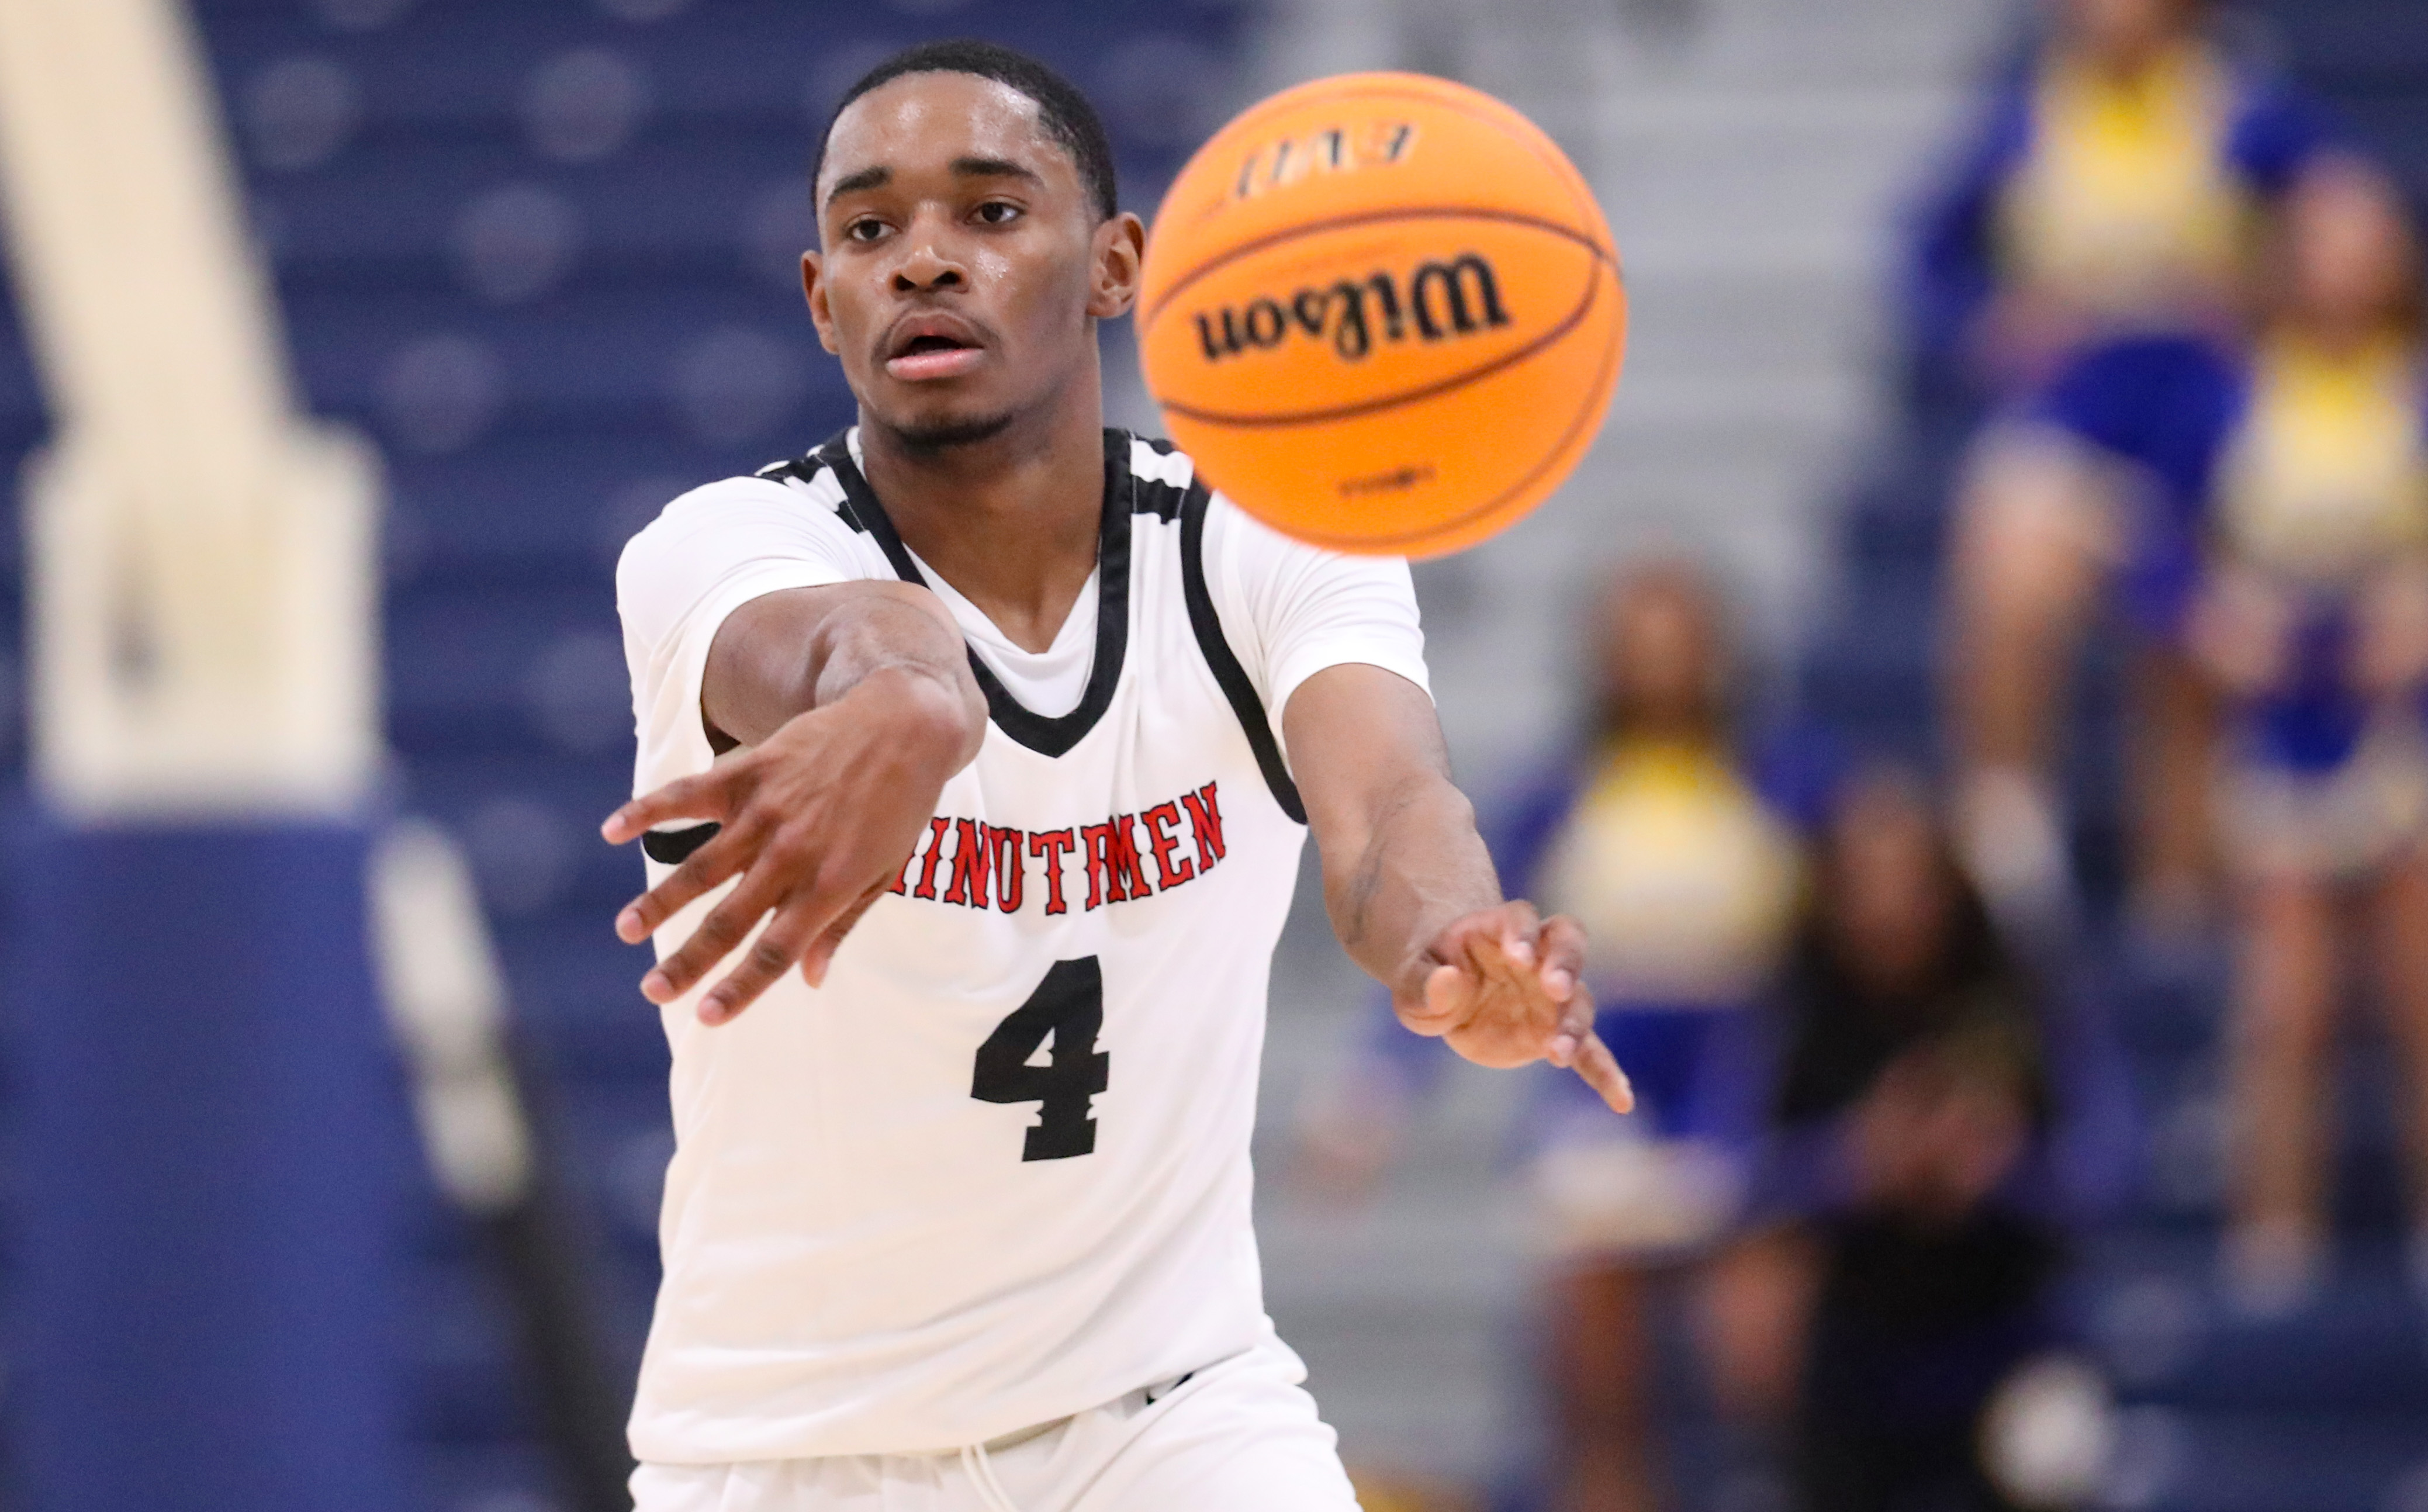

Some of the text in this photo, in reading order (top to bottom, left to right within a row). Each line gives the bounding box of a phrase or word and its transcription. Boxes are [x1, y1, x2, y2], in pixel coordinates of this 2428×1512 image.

[1193, 250, 1513, 363] Wilson
[886, 780, 1226, 916] INUTEMEN
[970, 954, 1110, 1162] 4
